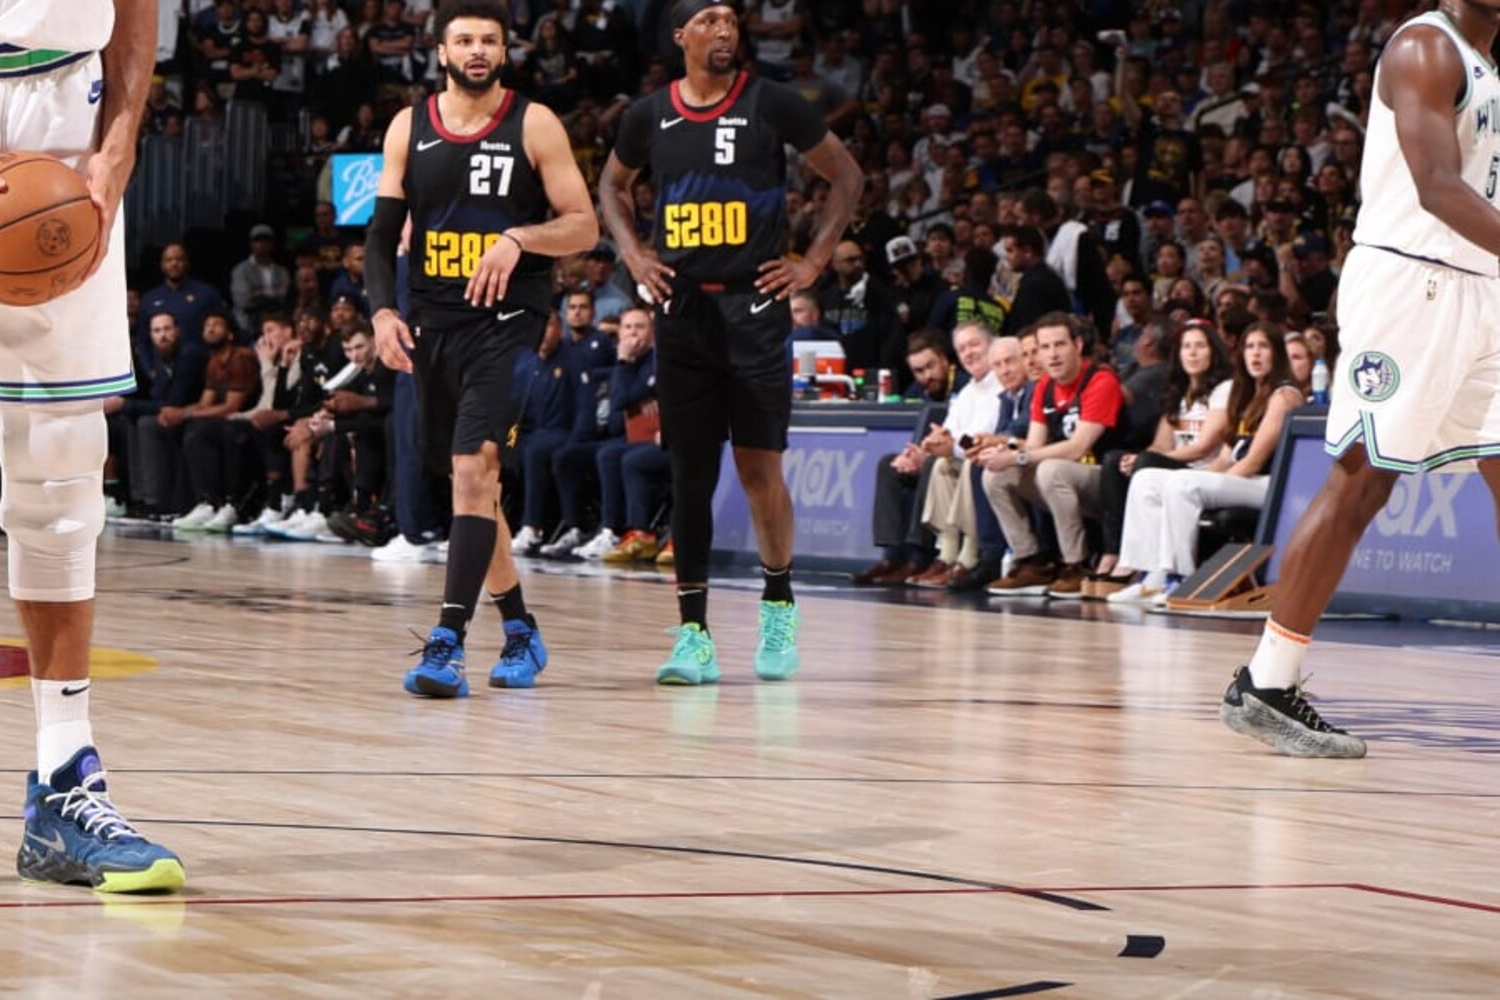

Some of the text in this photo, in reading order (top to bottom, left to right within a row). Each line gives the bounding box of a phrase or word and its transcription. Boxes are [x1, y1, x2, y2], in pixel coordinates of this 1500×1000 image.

[713, 127, 736, 166] 5
[468, 154, 515, 197] 27
[663, 200, 748, 250] 5280
[423, 230, 502, 279] 528
[1377, 472, 1471, 538] ax
[1375, 550, 1395, 567] TO
[1399, 552, 1453, 573] WATCH
